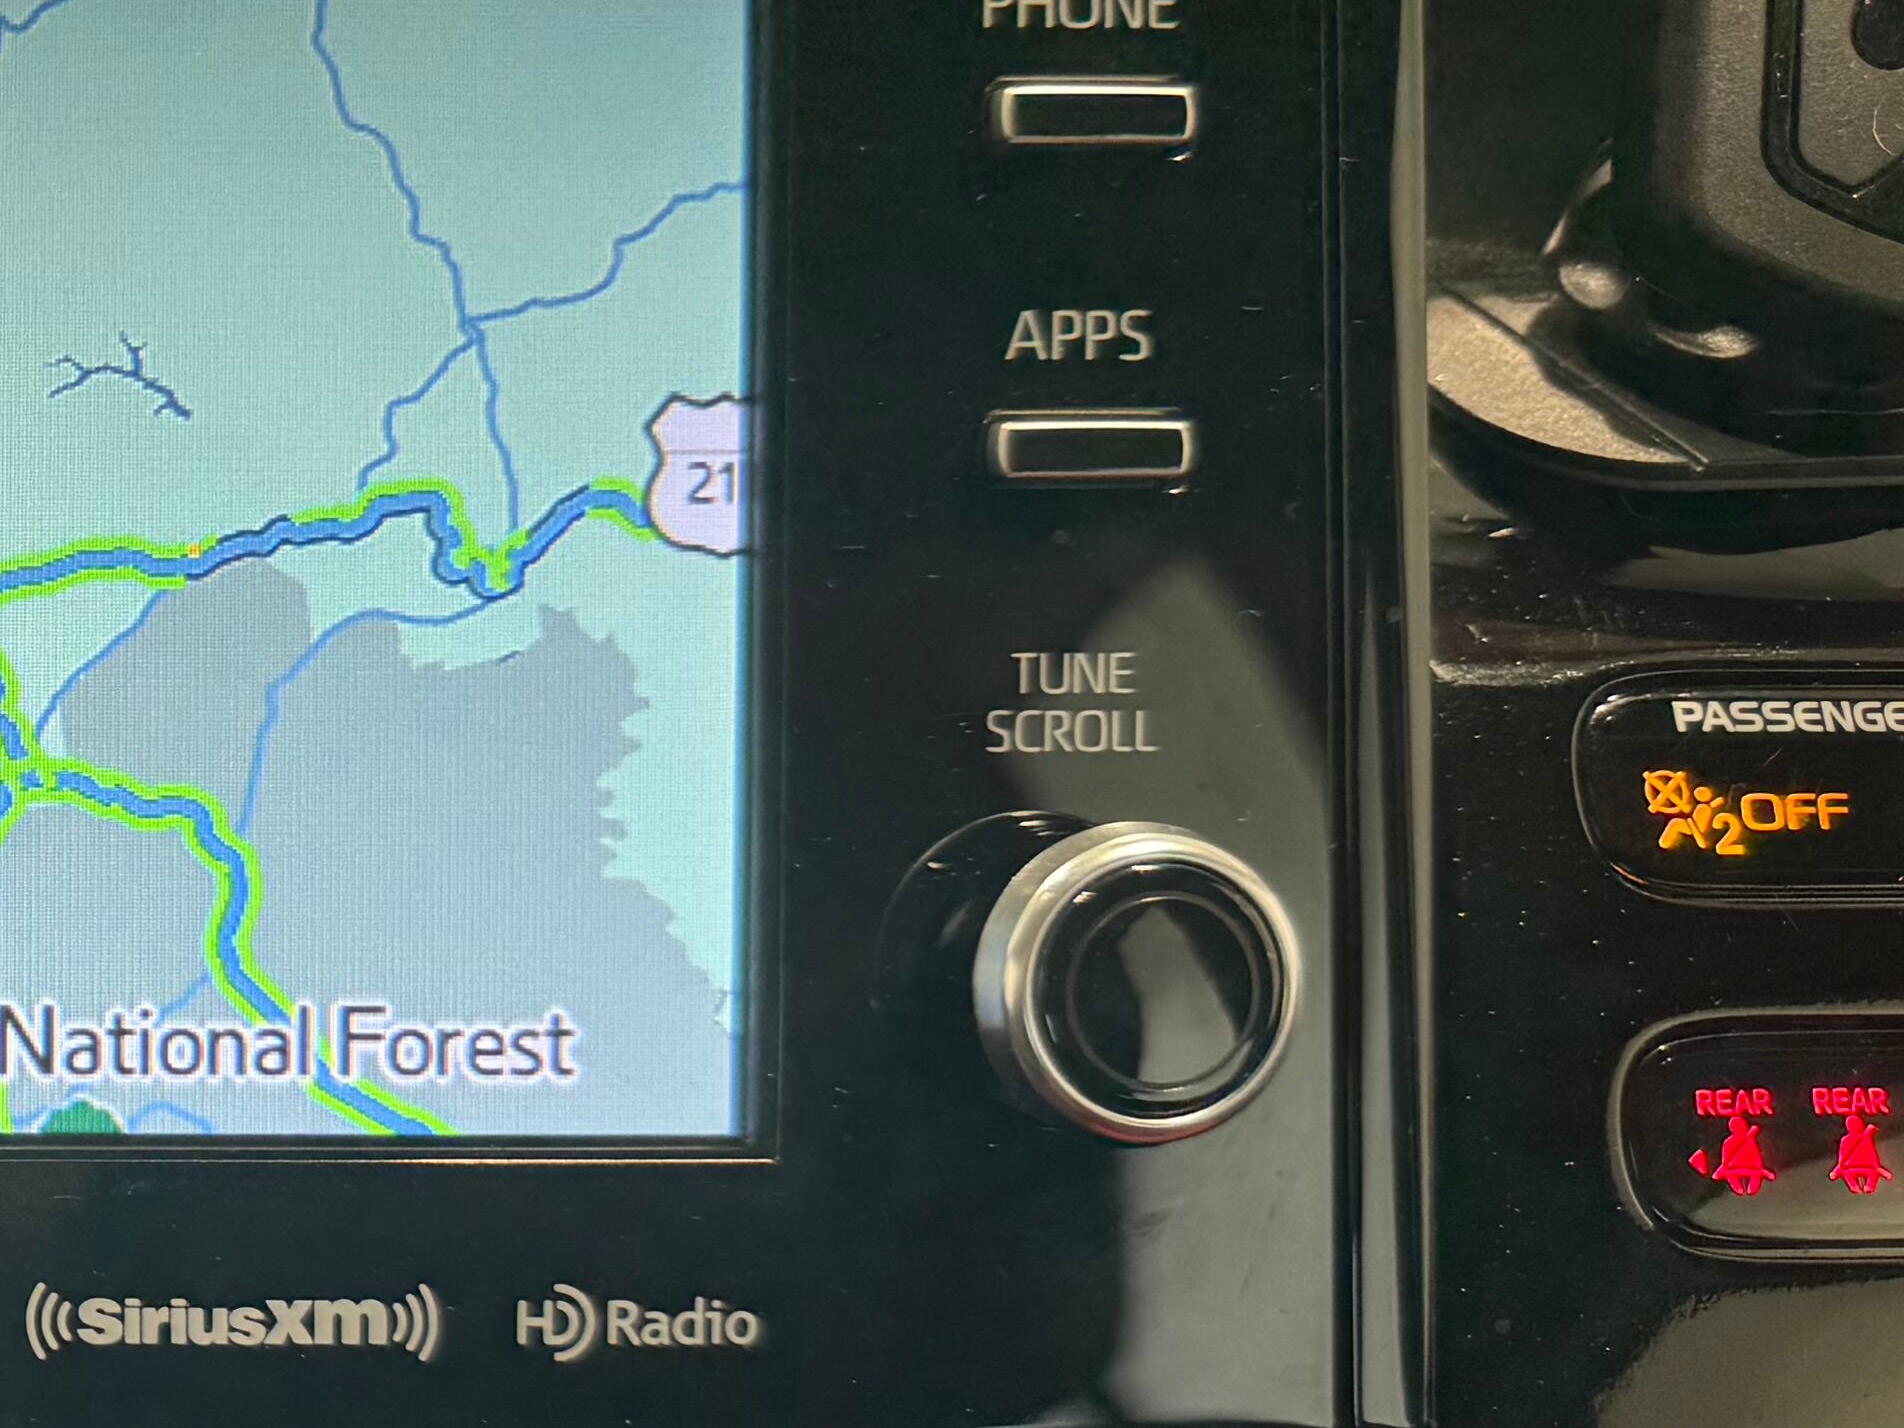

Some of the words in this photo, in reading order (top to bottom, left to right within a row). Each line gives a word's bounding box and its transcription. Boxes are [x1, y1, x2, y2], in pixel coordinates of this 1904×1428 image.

[1005, 309, 1153, 361] APPS
[1010, 652, 1138, 695] TUNE
[985, 710, 1161, 753] SCROLL
[1740, 792, 1849, 831] OFF
[337, 1004, 576, 1078] Forest
[1695, 1087, 1774, 1117] REAR
[1812, 1086, 1889, 1115] REAR
[516, 1287, 595, 1359] HD
[606, 1296, 760, 1347] Radio
